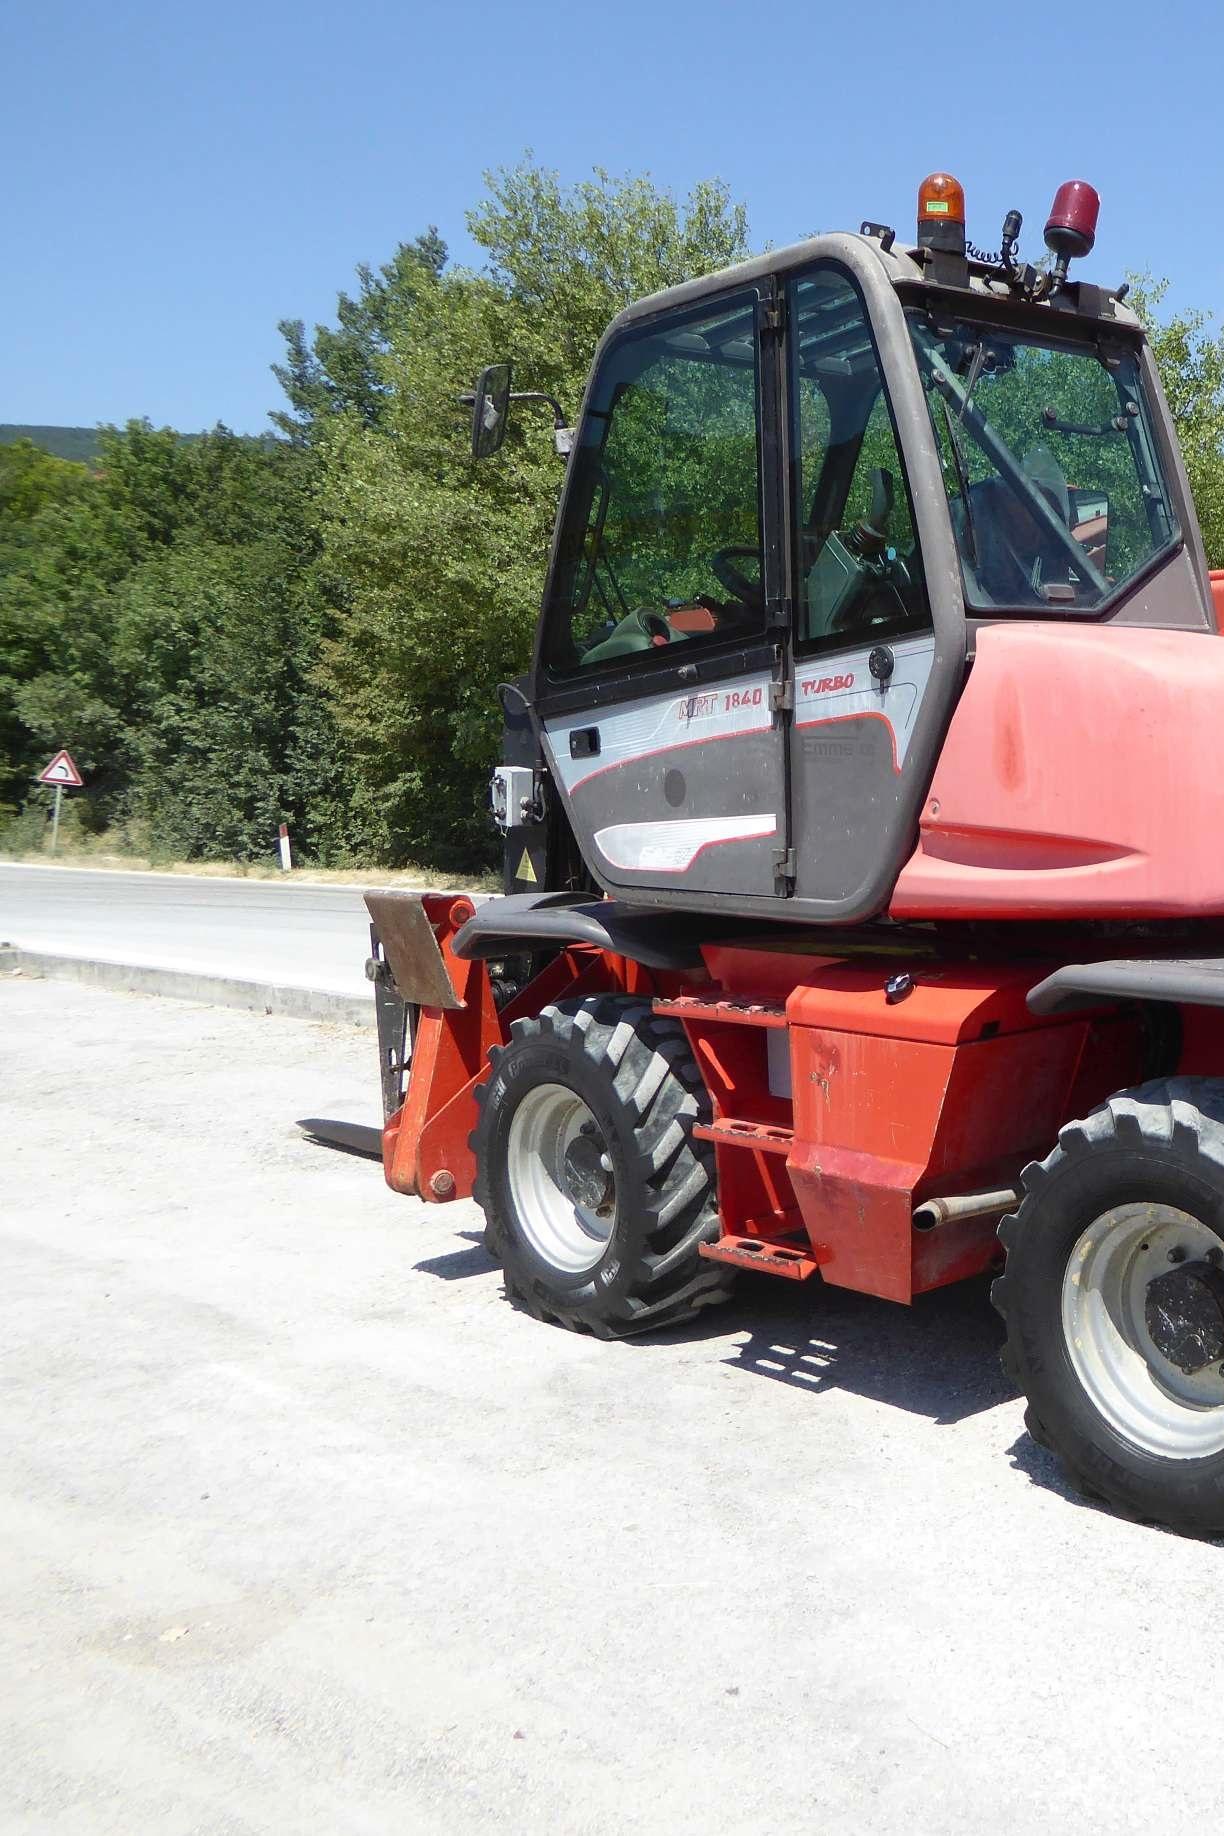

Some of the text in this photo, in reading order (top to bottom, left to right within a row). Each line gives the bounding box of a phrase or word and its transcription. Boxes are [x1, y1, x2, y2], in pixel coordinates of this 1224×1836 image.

[679, 673, 855, 720] MRT 1840 TURBO
